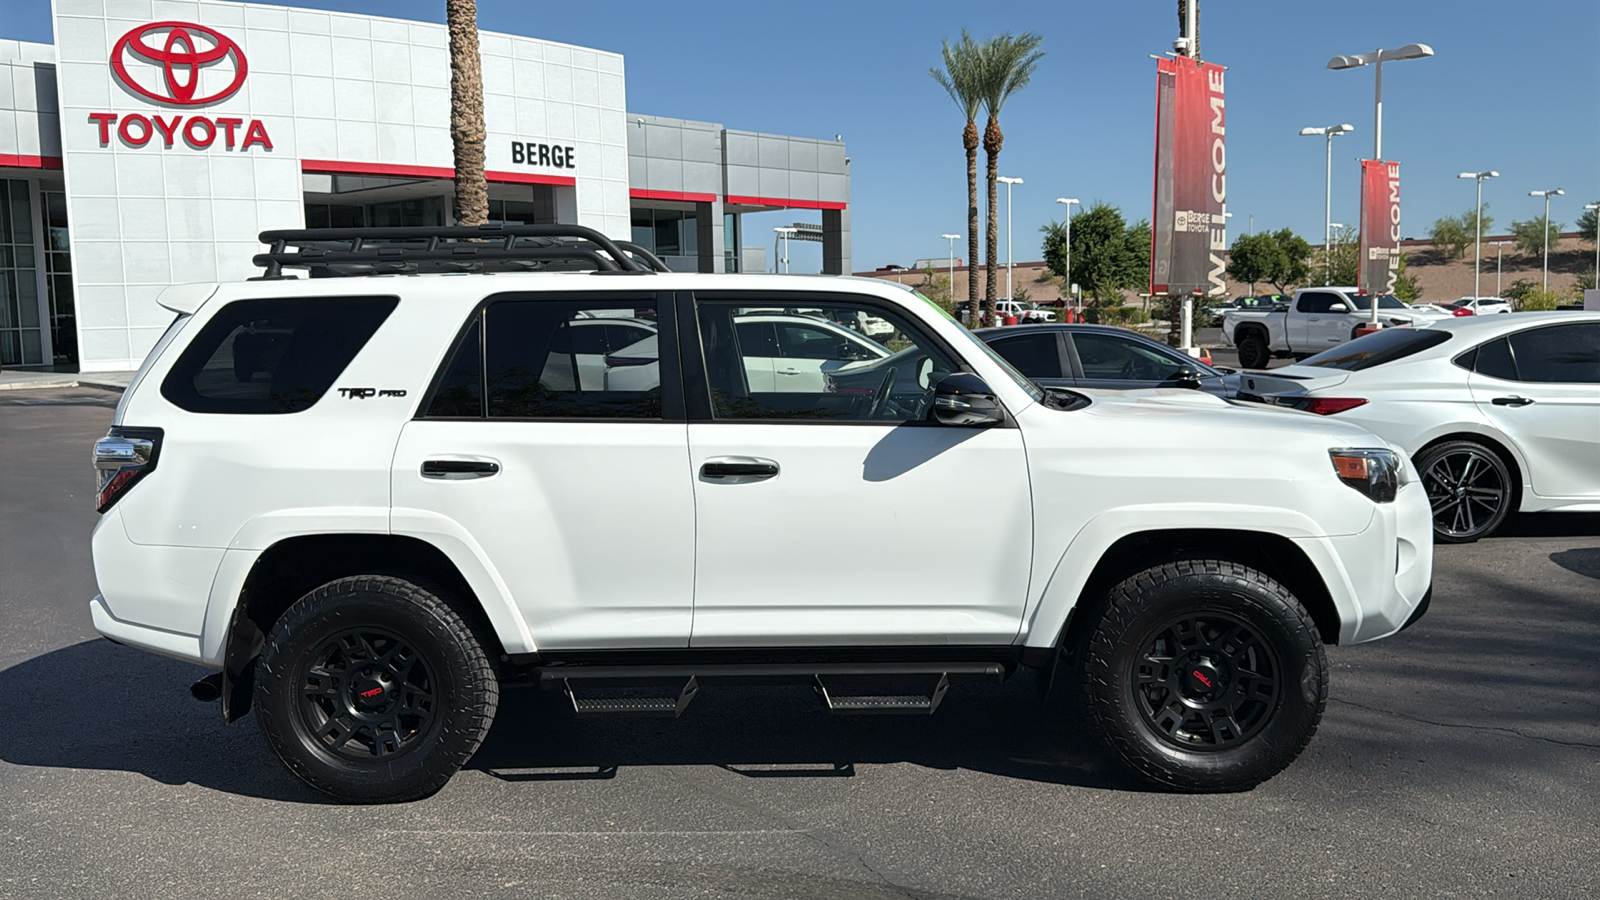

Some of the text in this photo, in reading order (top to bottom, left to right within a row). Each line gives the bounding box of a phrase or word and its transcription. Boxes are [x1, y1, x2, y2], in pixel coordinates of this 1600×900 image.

[88, 112, 274, 152] TOYOTA
[511, 141, 576, 169] BERGE
[1207, 69, 1226, 297] WELCOME
[1187, 224, 1210, 233] TOYOTA
[1384, 164, 1401, 296] WELCOME
[337, 387, 407, 400] TRD PRO
[360, 687, 382, 698] TRD
